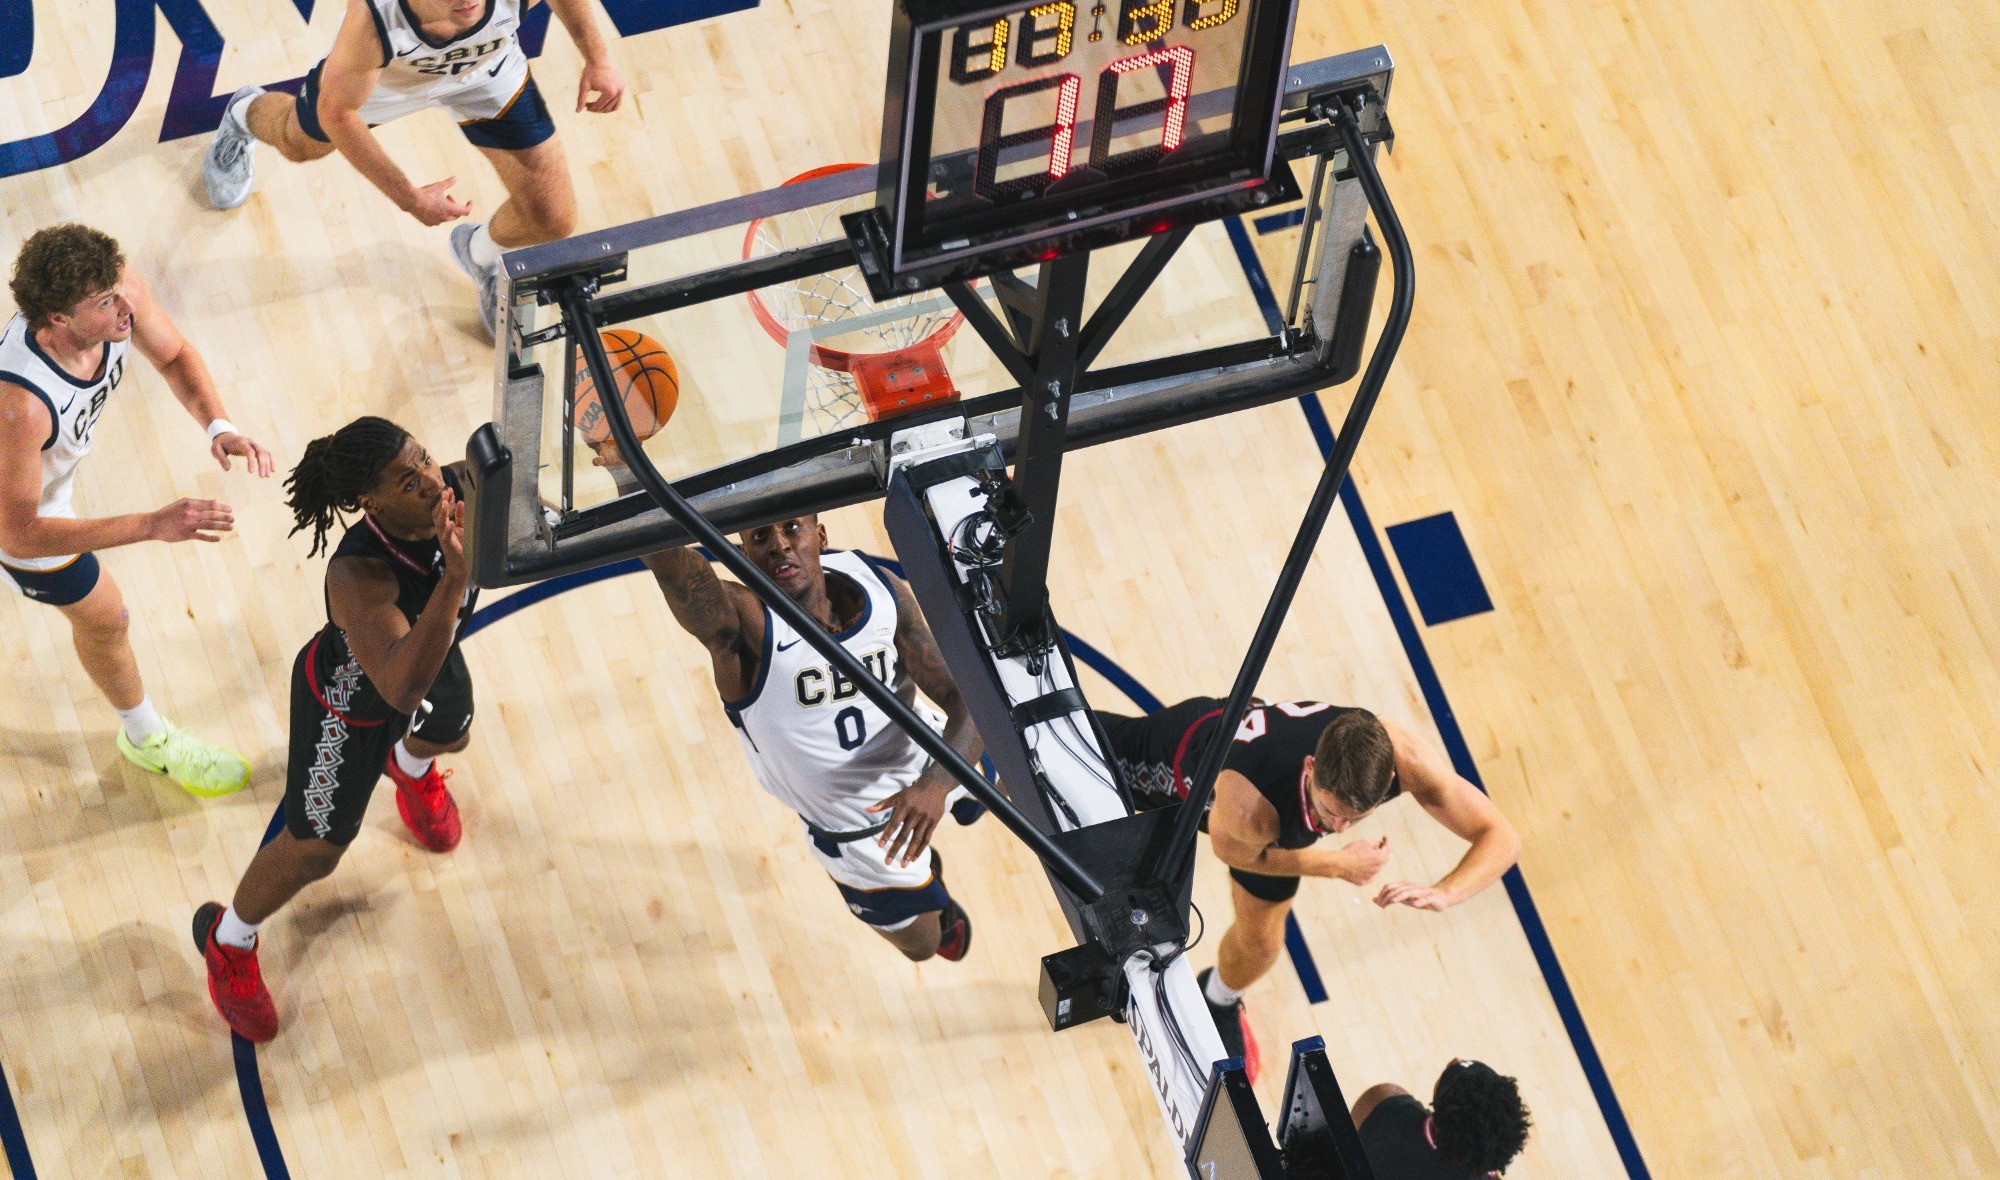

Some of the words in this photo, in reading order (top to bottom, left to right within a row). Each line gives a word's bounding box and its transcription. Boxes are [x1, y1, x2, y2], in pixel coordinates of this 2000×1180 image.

[410, 37, 503, 68] CBU
[73, 353, 124, 441] CBU
[794, 648, 890, 708] CBU
[834, 705, 867, 751] 0
